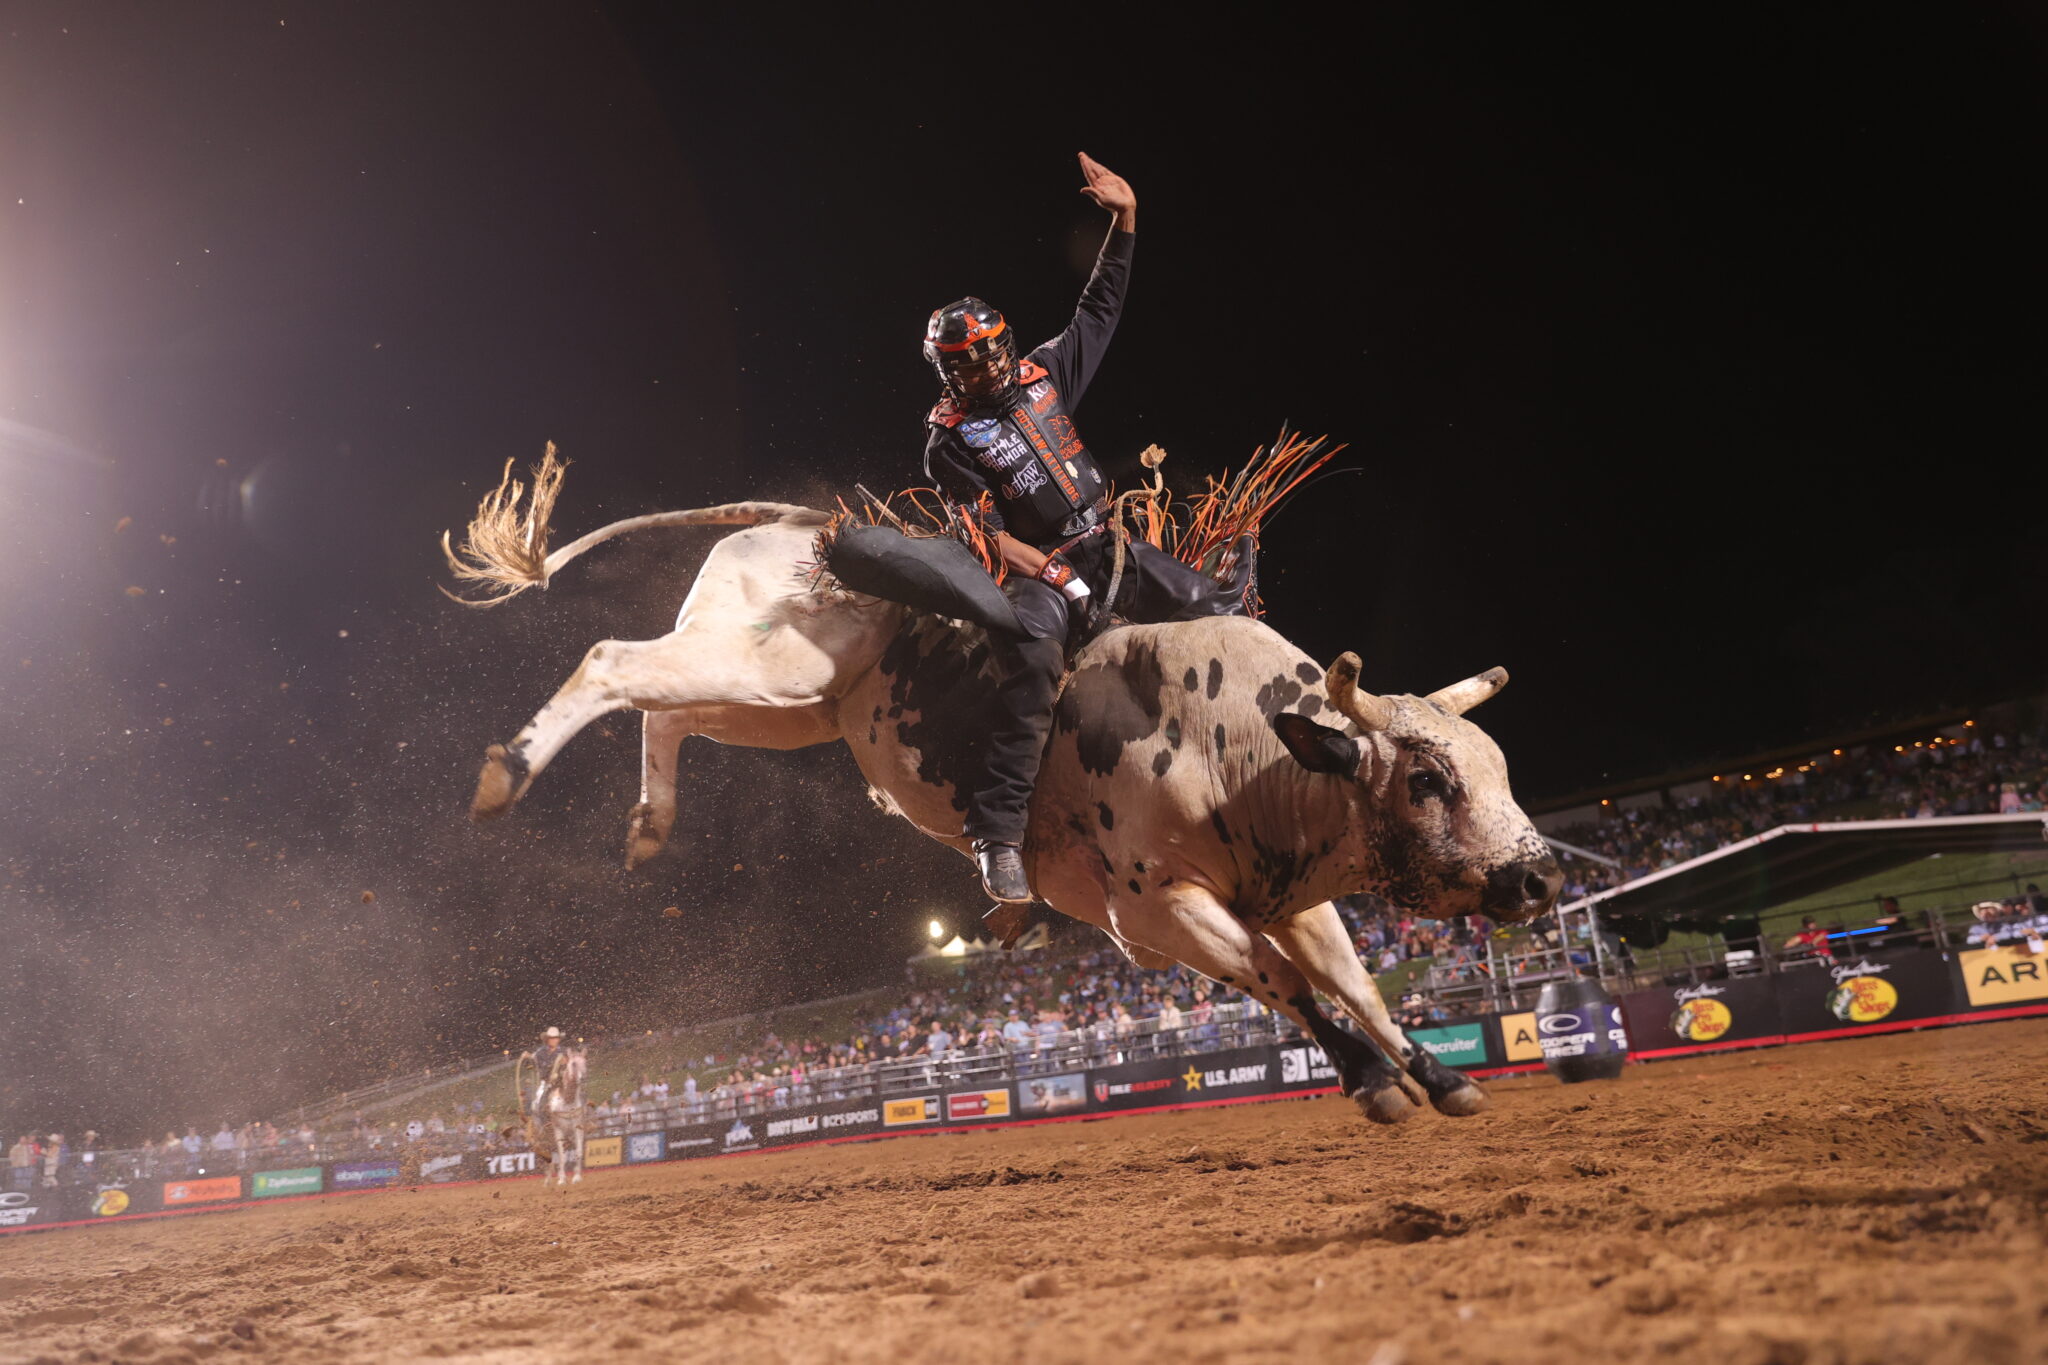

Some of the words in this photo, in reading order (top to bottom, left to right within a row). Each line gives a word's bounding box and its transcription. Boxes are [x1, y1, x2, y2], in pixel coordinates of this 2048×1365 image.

[1027, 382, 1049, 403] KC
[1014, 409, 1048, 451] OUTLAW
[1042, 451, 1081, 502] ATTITUDE
[1041, 560, 1061, 584] KC
[1205, 1070, 1229, 1087] U.S.
[1229, 1065, 1268, 1084] ARMY
[845, 1109, 879, 1125] SPORTS
[486, 1153, 535, 1174] YETI
